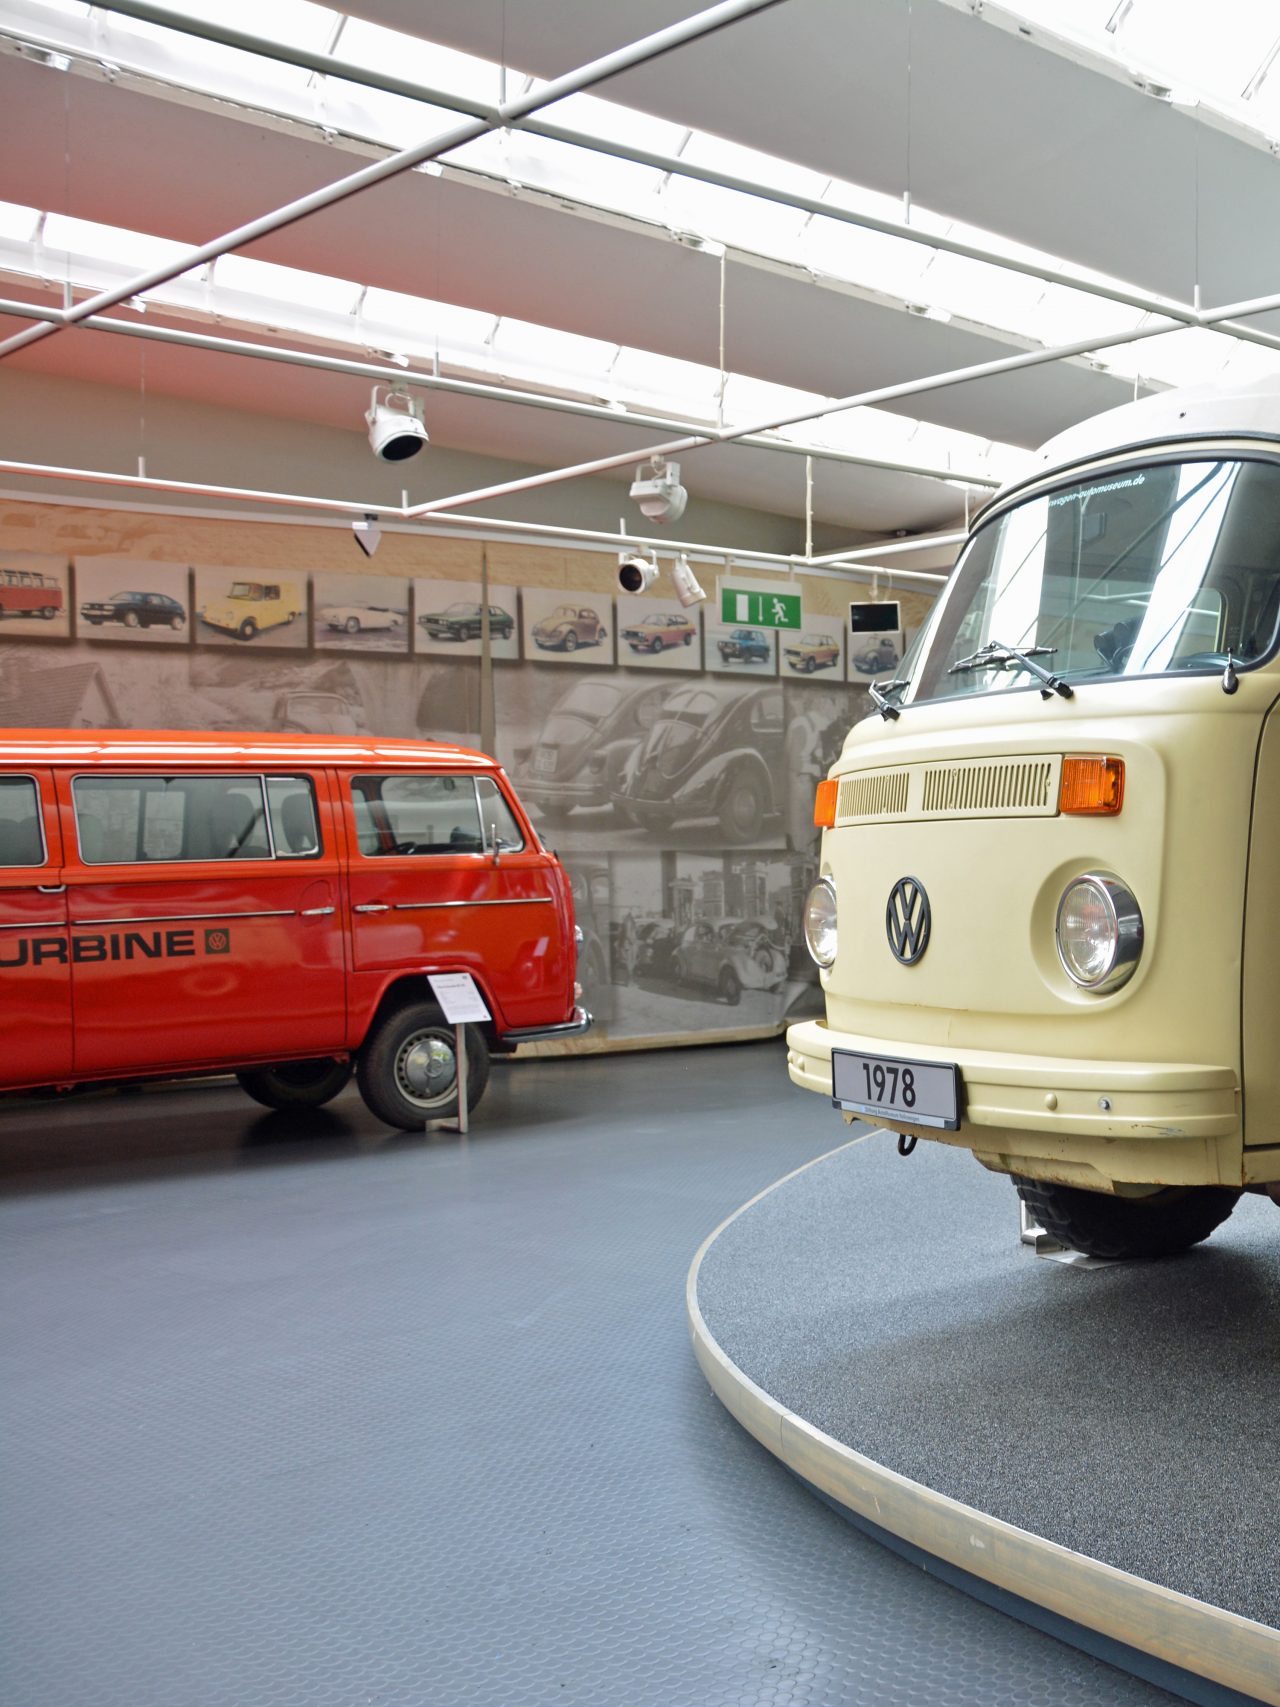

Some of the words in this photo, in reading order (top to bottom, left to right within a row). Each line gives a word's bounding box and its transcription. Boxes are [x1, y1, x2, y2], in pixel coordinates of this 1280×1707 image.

[1047, 473, 1146, 507] wagen-automuseum.de
[886, 876, 932, 966] VW
[0, 930, 195, 967] URBINE
[863, 1063, 916, 1107] 1978
